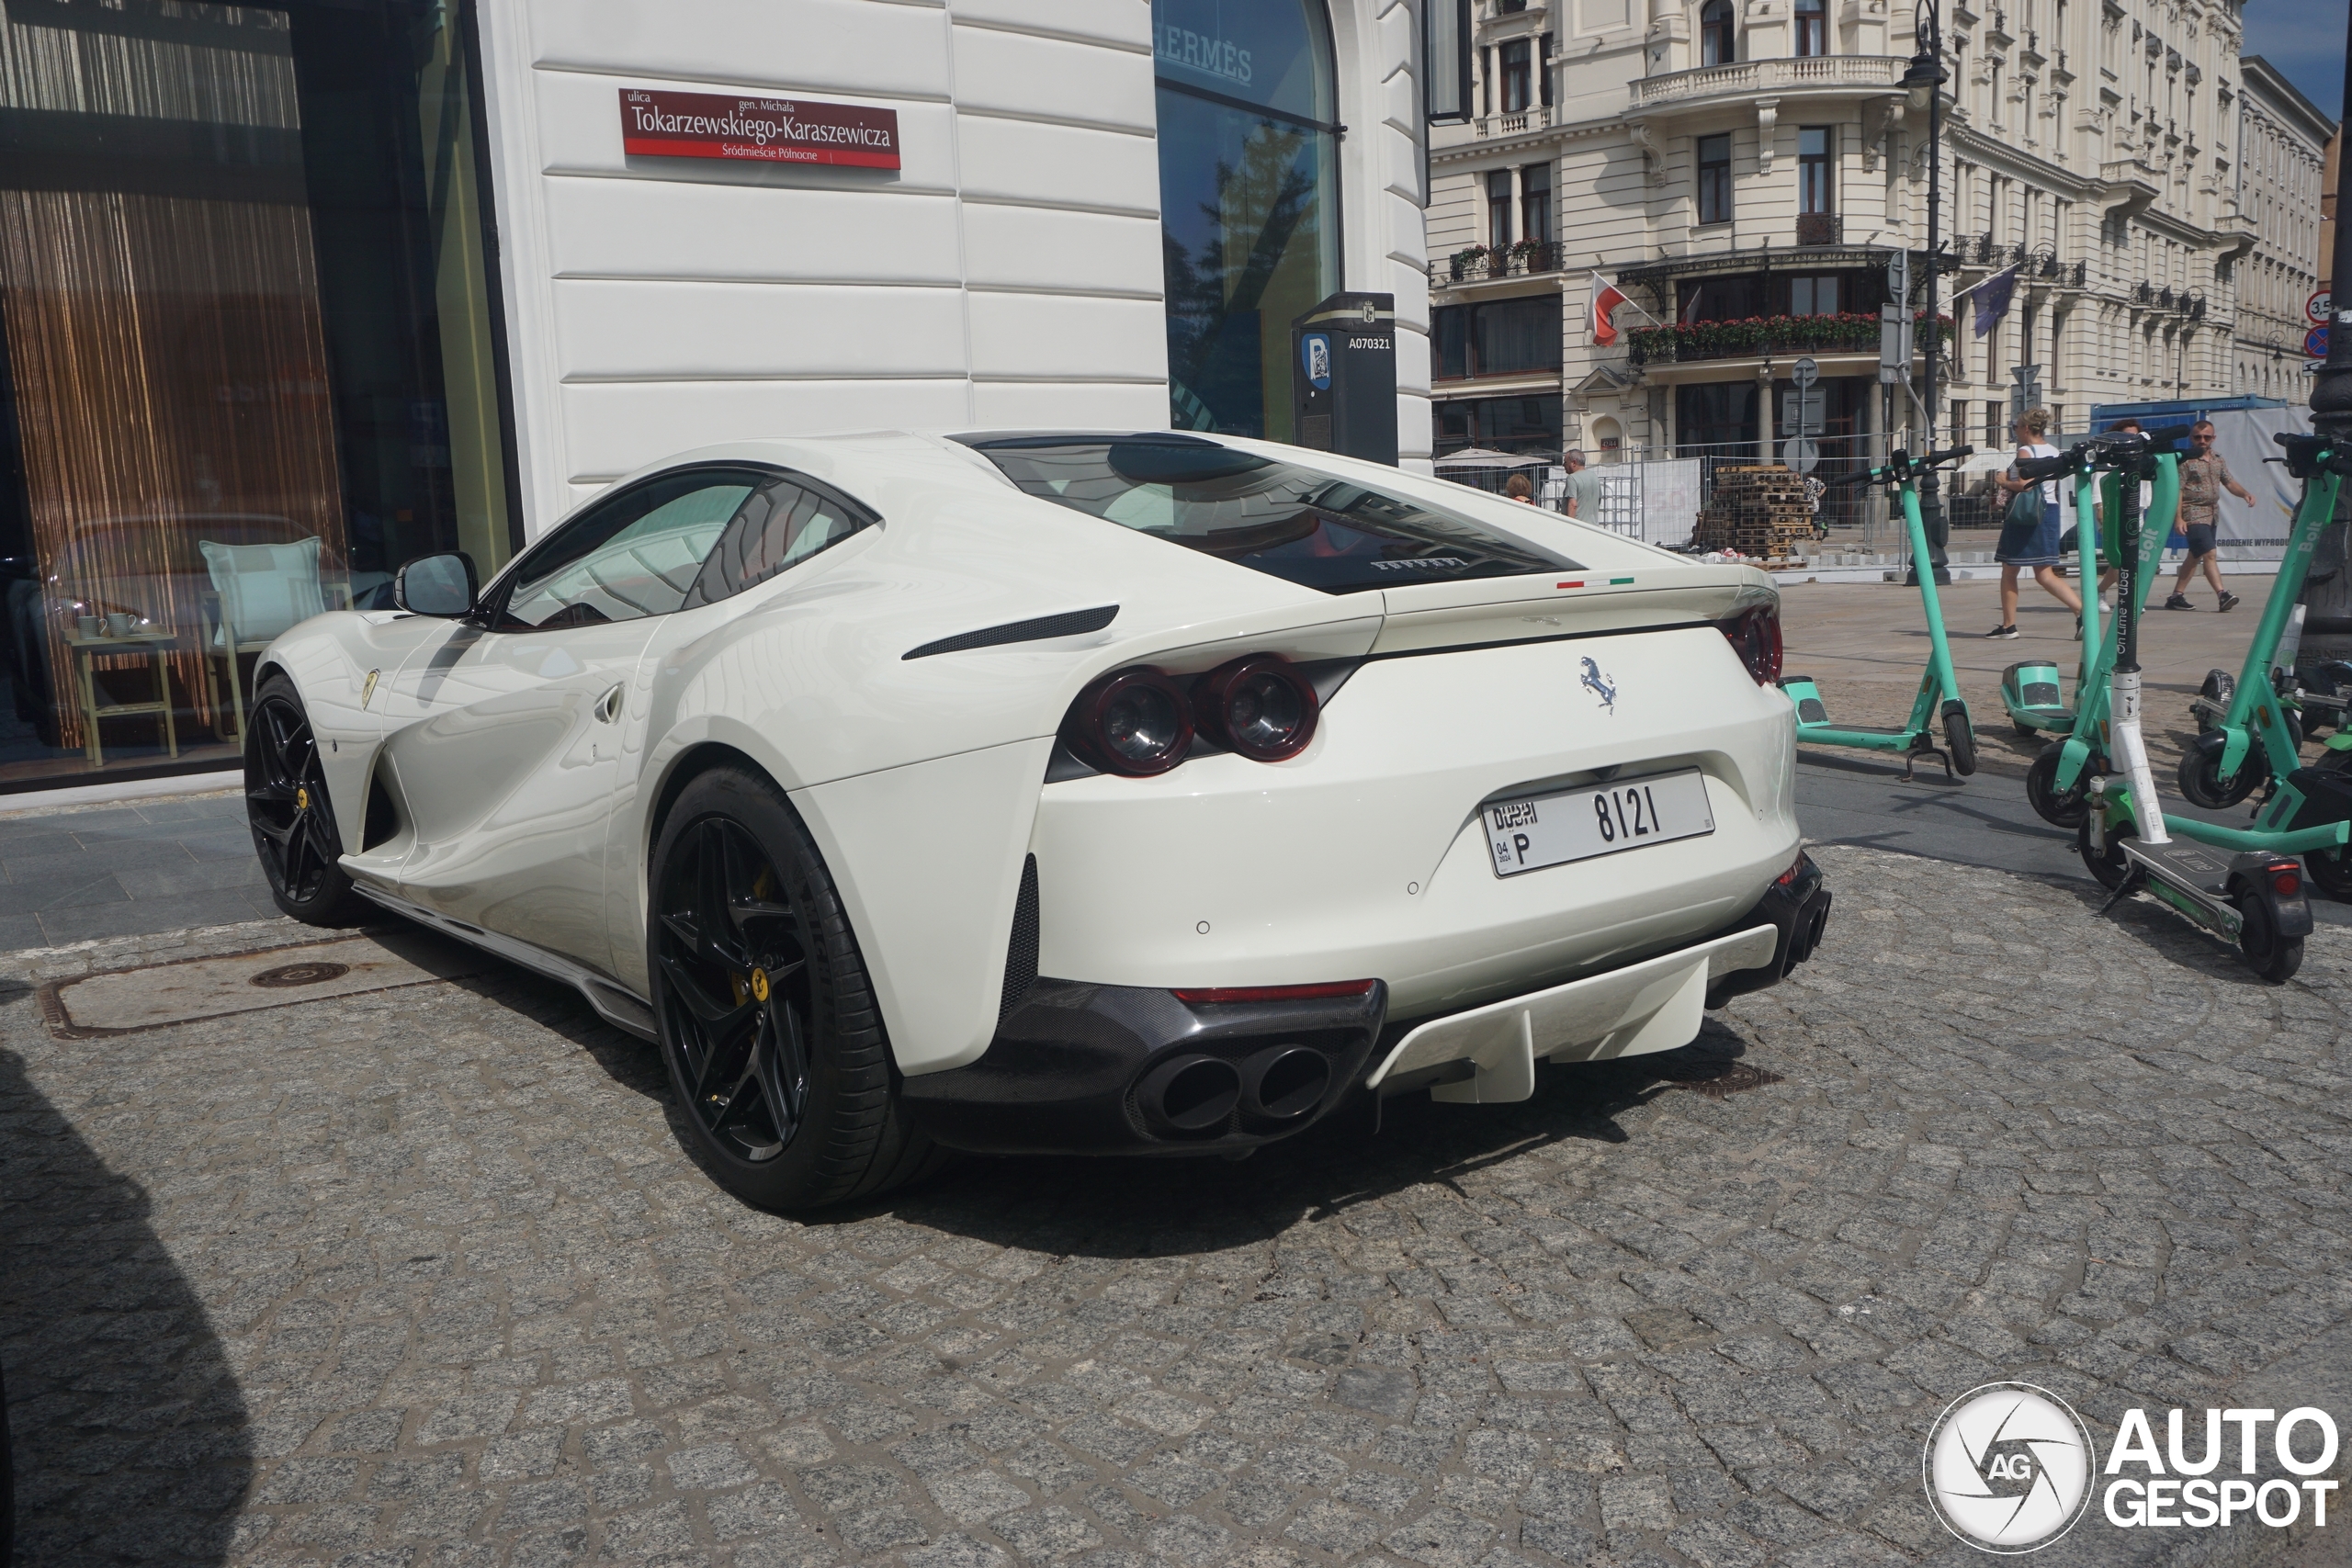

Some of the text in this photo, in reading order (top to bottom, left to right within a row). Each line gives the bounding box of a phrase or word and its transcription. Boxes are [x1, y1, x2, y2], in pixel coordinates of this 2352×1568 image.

[628, 91, 650, 103] ulica
[739, 100, 795, 112] gen. Michała
[631, 106, 890, 147] Tokarzewskiego-Karaszewicza
[722, 143, 817, 160] Śródmieście Północne
[1349, 338, 1390, 350] A070321
[2138, 527, 2159, 562] Bolt
[2215, 538, 2253, 547] GRODZENIE
[2298, 521, 2323, 552] Bolt
[2119, 568, 2129, 595] Uber
[2118, 607, 2127, 636] Lime
[1593, 785, 1660, 842] 8121
[1497, 841, 1509, 855] 04
[1499, 855, 1510, 863] 2024
[1513, 833, 1530, 865] P
